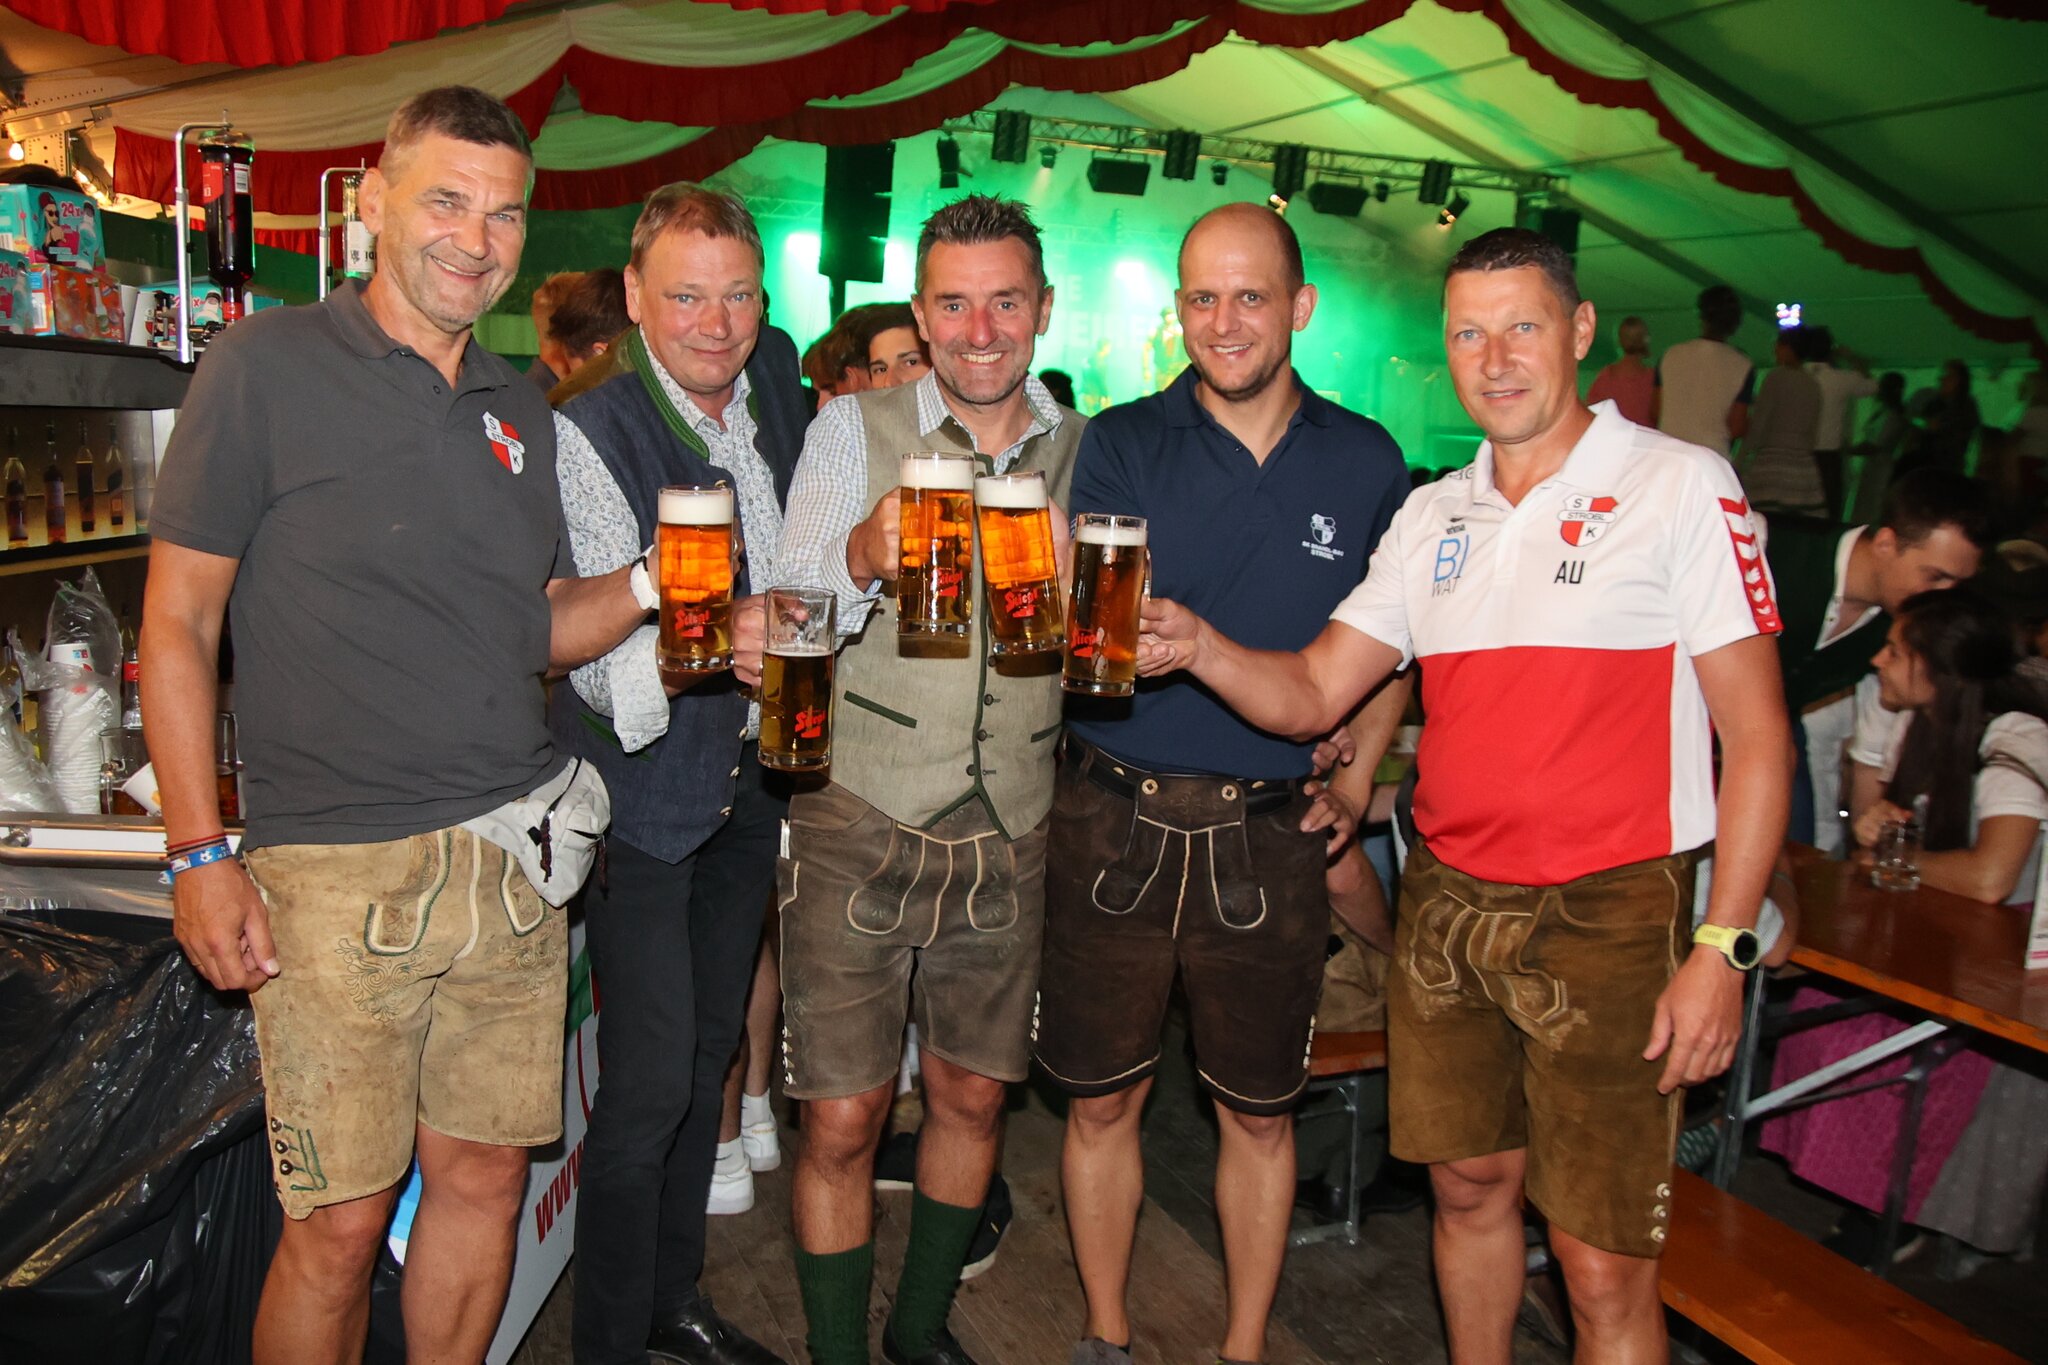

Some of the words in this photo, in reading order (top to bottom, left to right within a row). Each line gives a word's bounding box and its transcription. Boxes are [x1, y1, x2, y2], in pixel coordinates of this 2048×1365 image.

[1573, 498, 1583, 509] S
[1567, 512, 1605, 521] STROBL
[1585, 526, 1598, 538] K
[1553, 560, 1585, 584] AU
